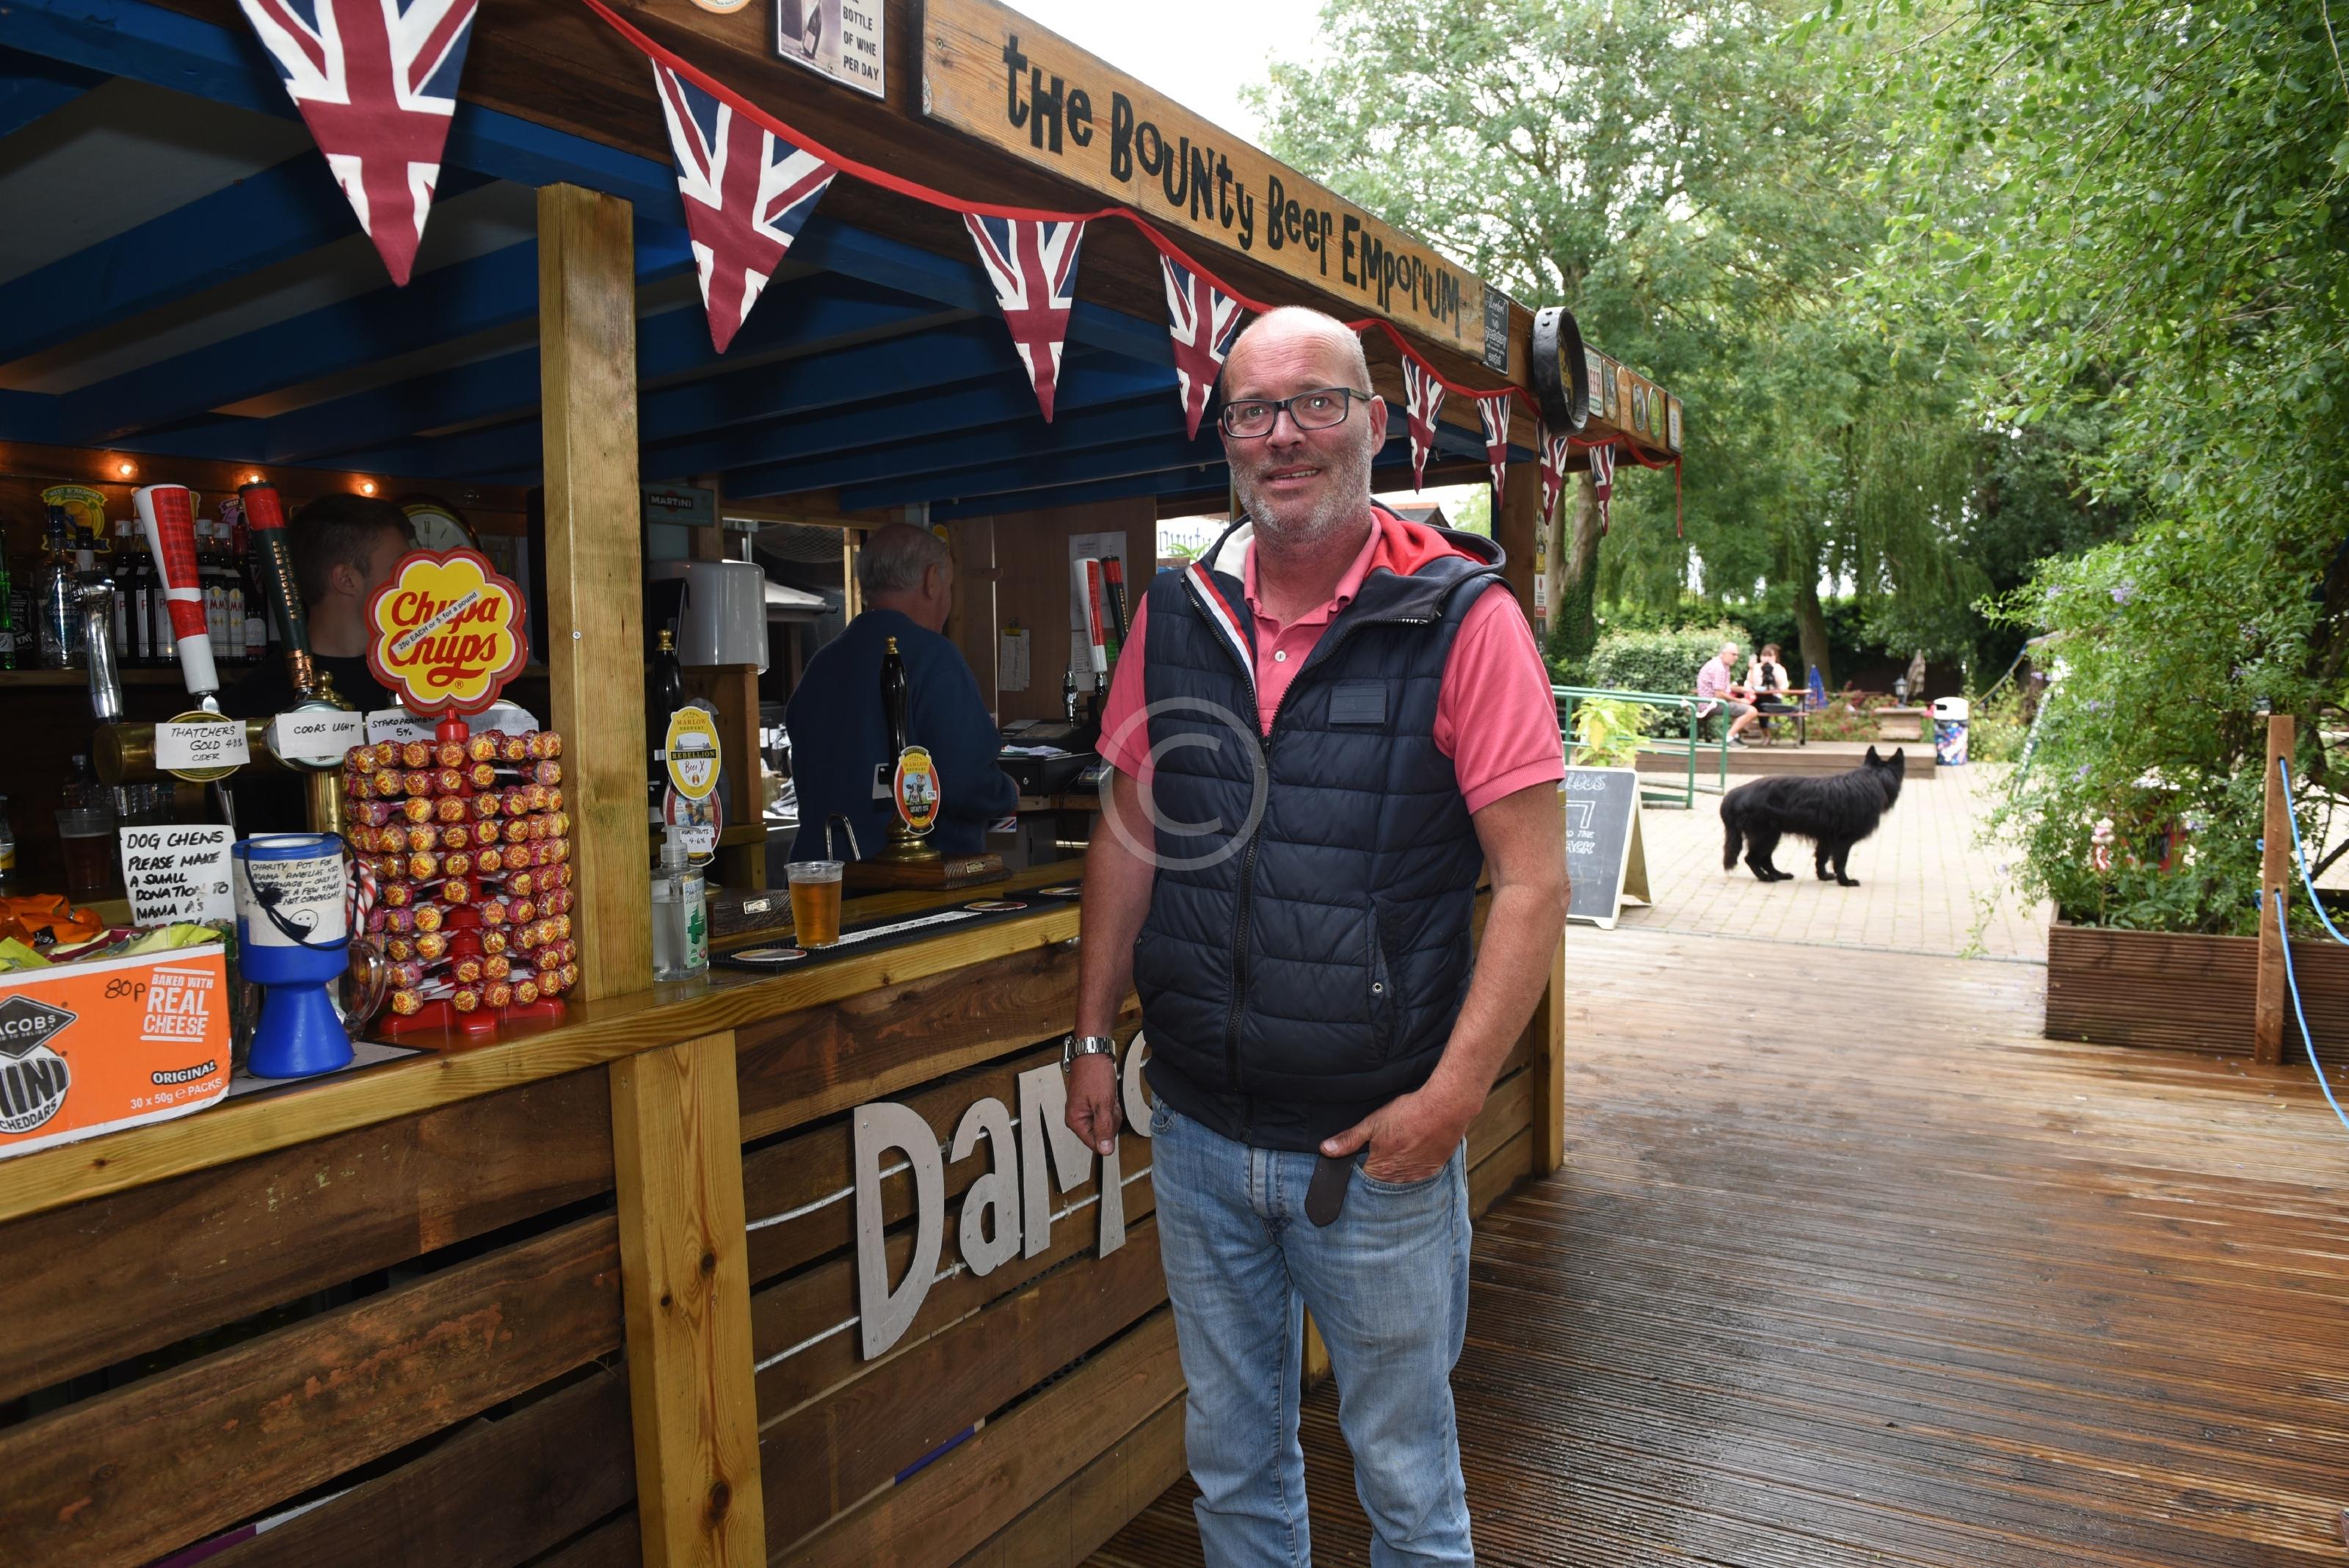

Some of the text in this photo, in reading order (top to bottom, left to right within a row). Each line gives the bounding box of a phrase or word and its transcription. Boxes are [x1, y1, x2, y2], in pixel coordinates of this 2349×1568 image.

[843, 6, 872, 31] BOTTLE
[843, 31, 876, 57] OF WINE
[843, 55, 879, 81] PER DAY
[1589, 369, 1601, 397] EER
[650, 495, 691, 507] MARTINI
[272, 540, 283, 565] BEER
[279, 568, 294, 606] PRAGUE
[391, 591, 501, 634] Chupa
[398, 639, 410, 650] 25p
[410, 626, 428, 642] EACH
[429, 621, 436, 629] or
[442, 611, 452, 620] for
[458, 592, 477, 609] pound
[388, 628, 498, 687] Chups
[293, 723, 355, 734] COORS LIGHT
[371, 716, 435, 728] STAROPRAMEN
[170, 725, 236, 738] THATCHERS
[396, 727, 413, 736] 5%
[190, 739, 220, 750] GOLD
[192, 752, 220, 761] CIDER
[672, 750, 715, 760] REBELLION
[685, 761, 705, 774] Beer X
[127, 830, 224, 850] DOG CHEWS
[1578, 830, 1595, 838] THE
[1566, 841, 1596, 854] ACK
[128, 852, 221, 872] PLEASE MAKE
[252, 863, 288, 871] CHARITY
[296, 861, 314, 869] POT
[129, 873, 188, 888] A SMALL
[213, 881, 229, 894] TO
[313, 876, 330, 885] ONLY
[302, 887, 319, 895] FEW
[283, 896, 300, 905] NOT
[137, 904, 178, 921] MAMA
[105, 979, 146, 1002] 80p
[151, 974, 214, 989] BAKED WITH
[147, 987, 210, 1016] REAL
[0, 1015, 57, 1036] COBS
[143, 1015, 208, 1036] CHEESE
[153, 1061, 217, 1084] ORIGINAL
[0, 1058, 70, 1118] INI
[130, 1097, 142, 1109] 30
[145, 1097, 153, 1106] x
[154, 1092, 173, 1104] 50g
[188, 1078, 222, 1096] PACKS
[0, 1098, 57, 1130] CHEDDARS
